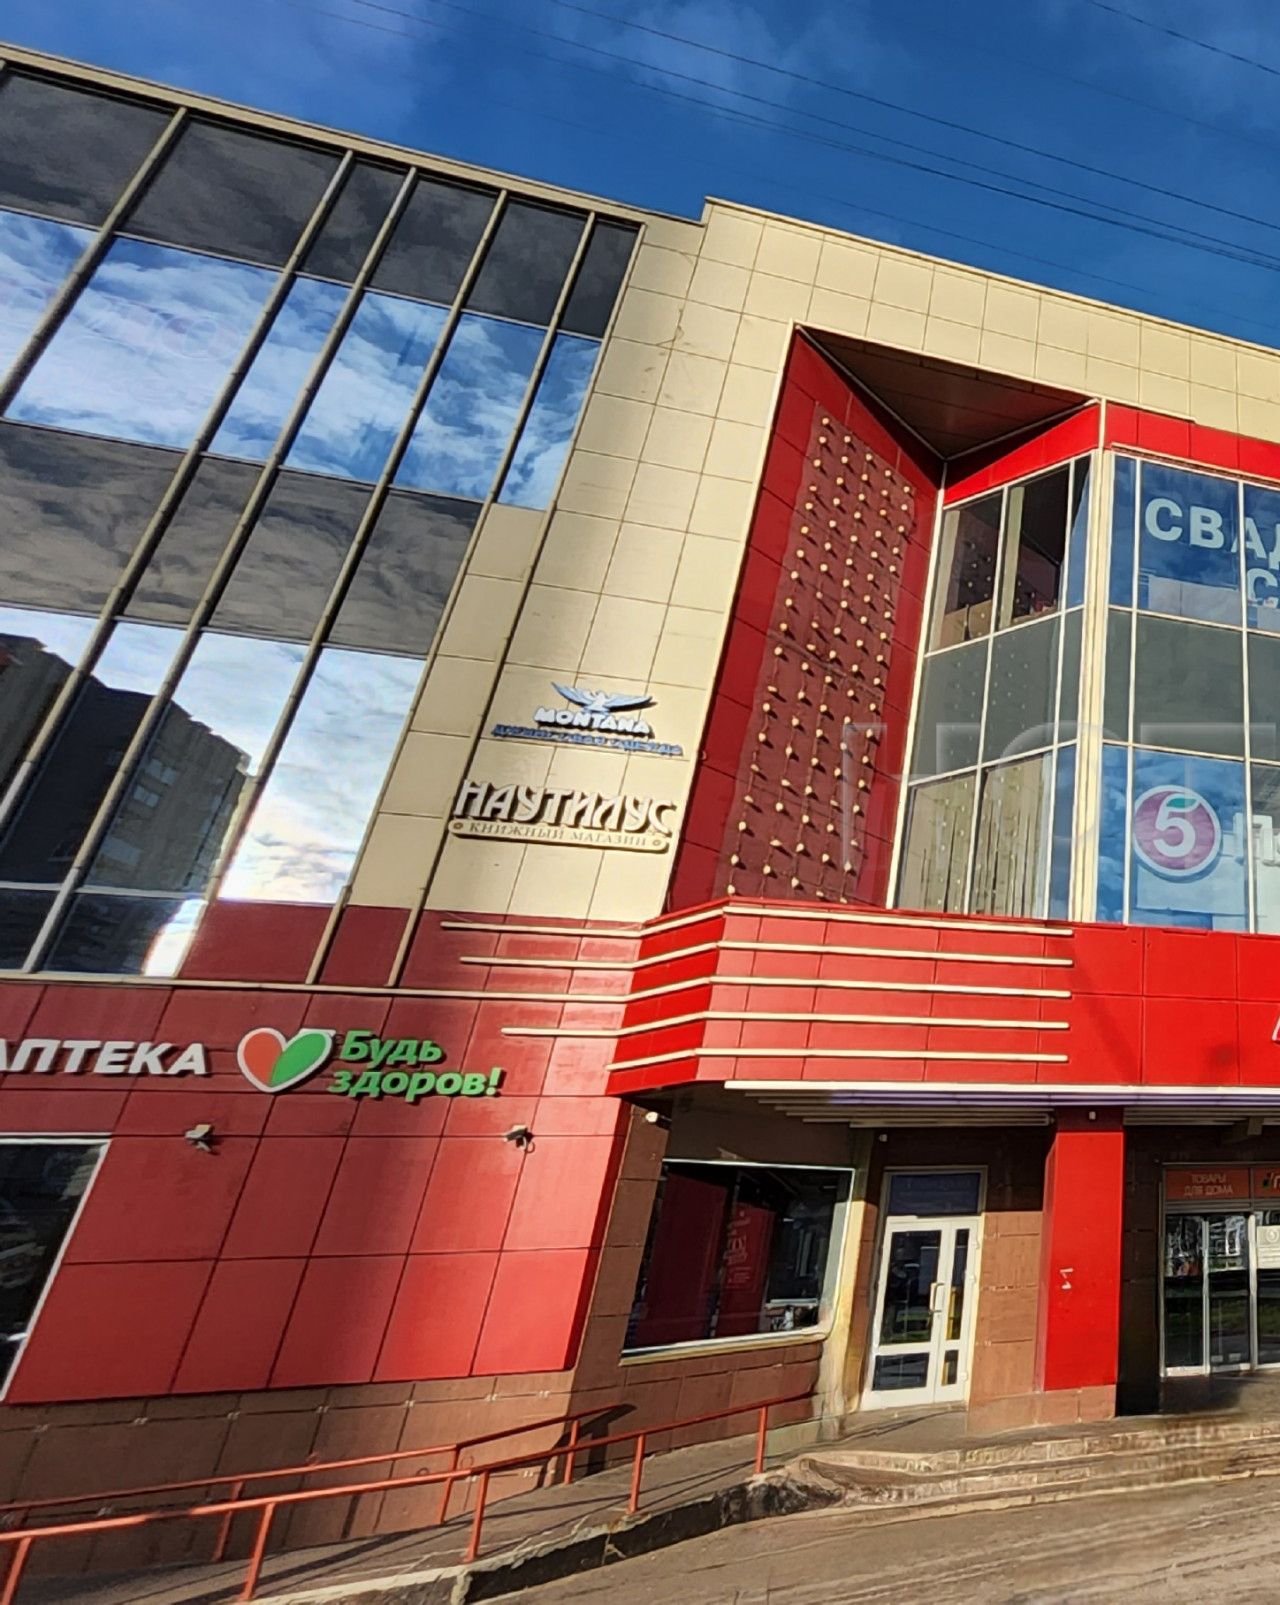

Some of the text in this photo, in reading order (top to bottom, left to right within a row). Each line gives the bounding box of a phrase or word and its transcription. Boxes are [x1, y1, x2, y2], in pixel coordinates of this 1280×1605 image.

[533, 707, 652, 734] MONTANA
[453, 779, 678, 837] НАУТИЛУС
[469, 821, 647, 848] КНИЖНЫЙ МАГАЗИН
[0, 1038, 207, 1075] ПТЕКА
[339, 1031, 444, 1066] Будь
[328, 1068, 502, 1102] здоров!
